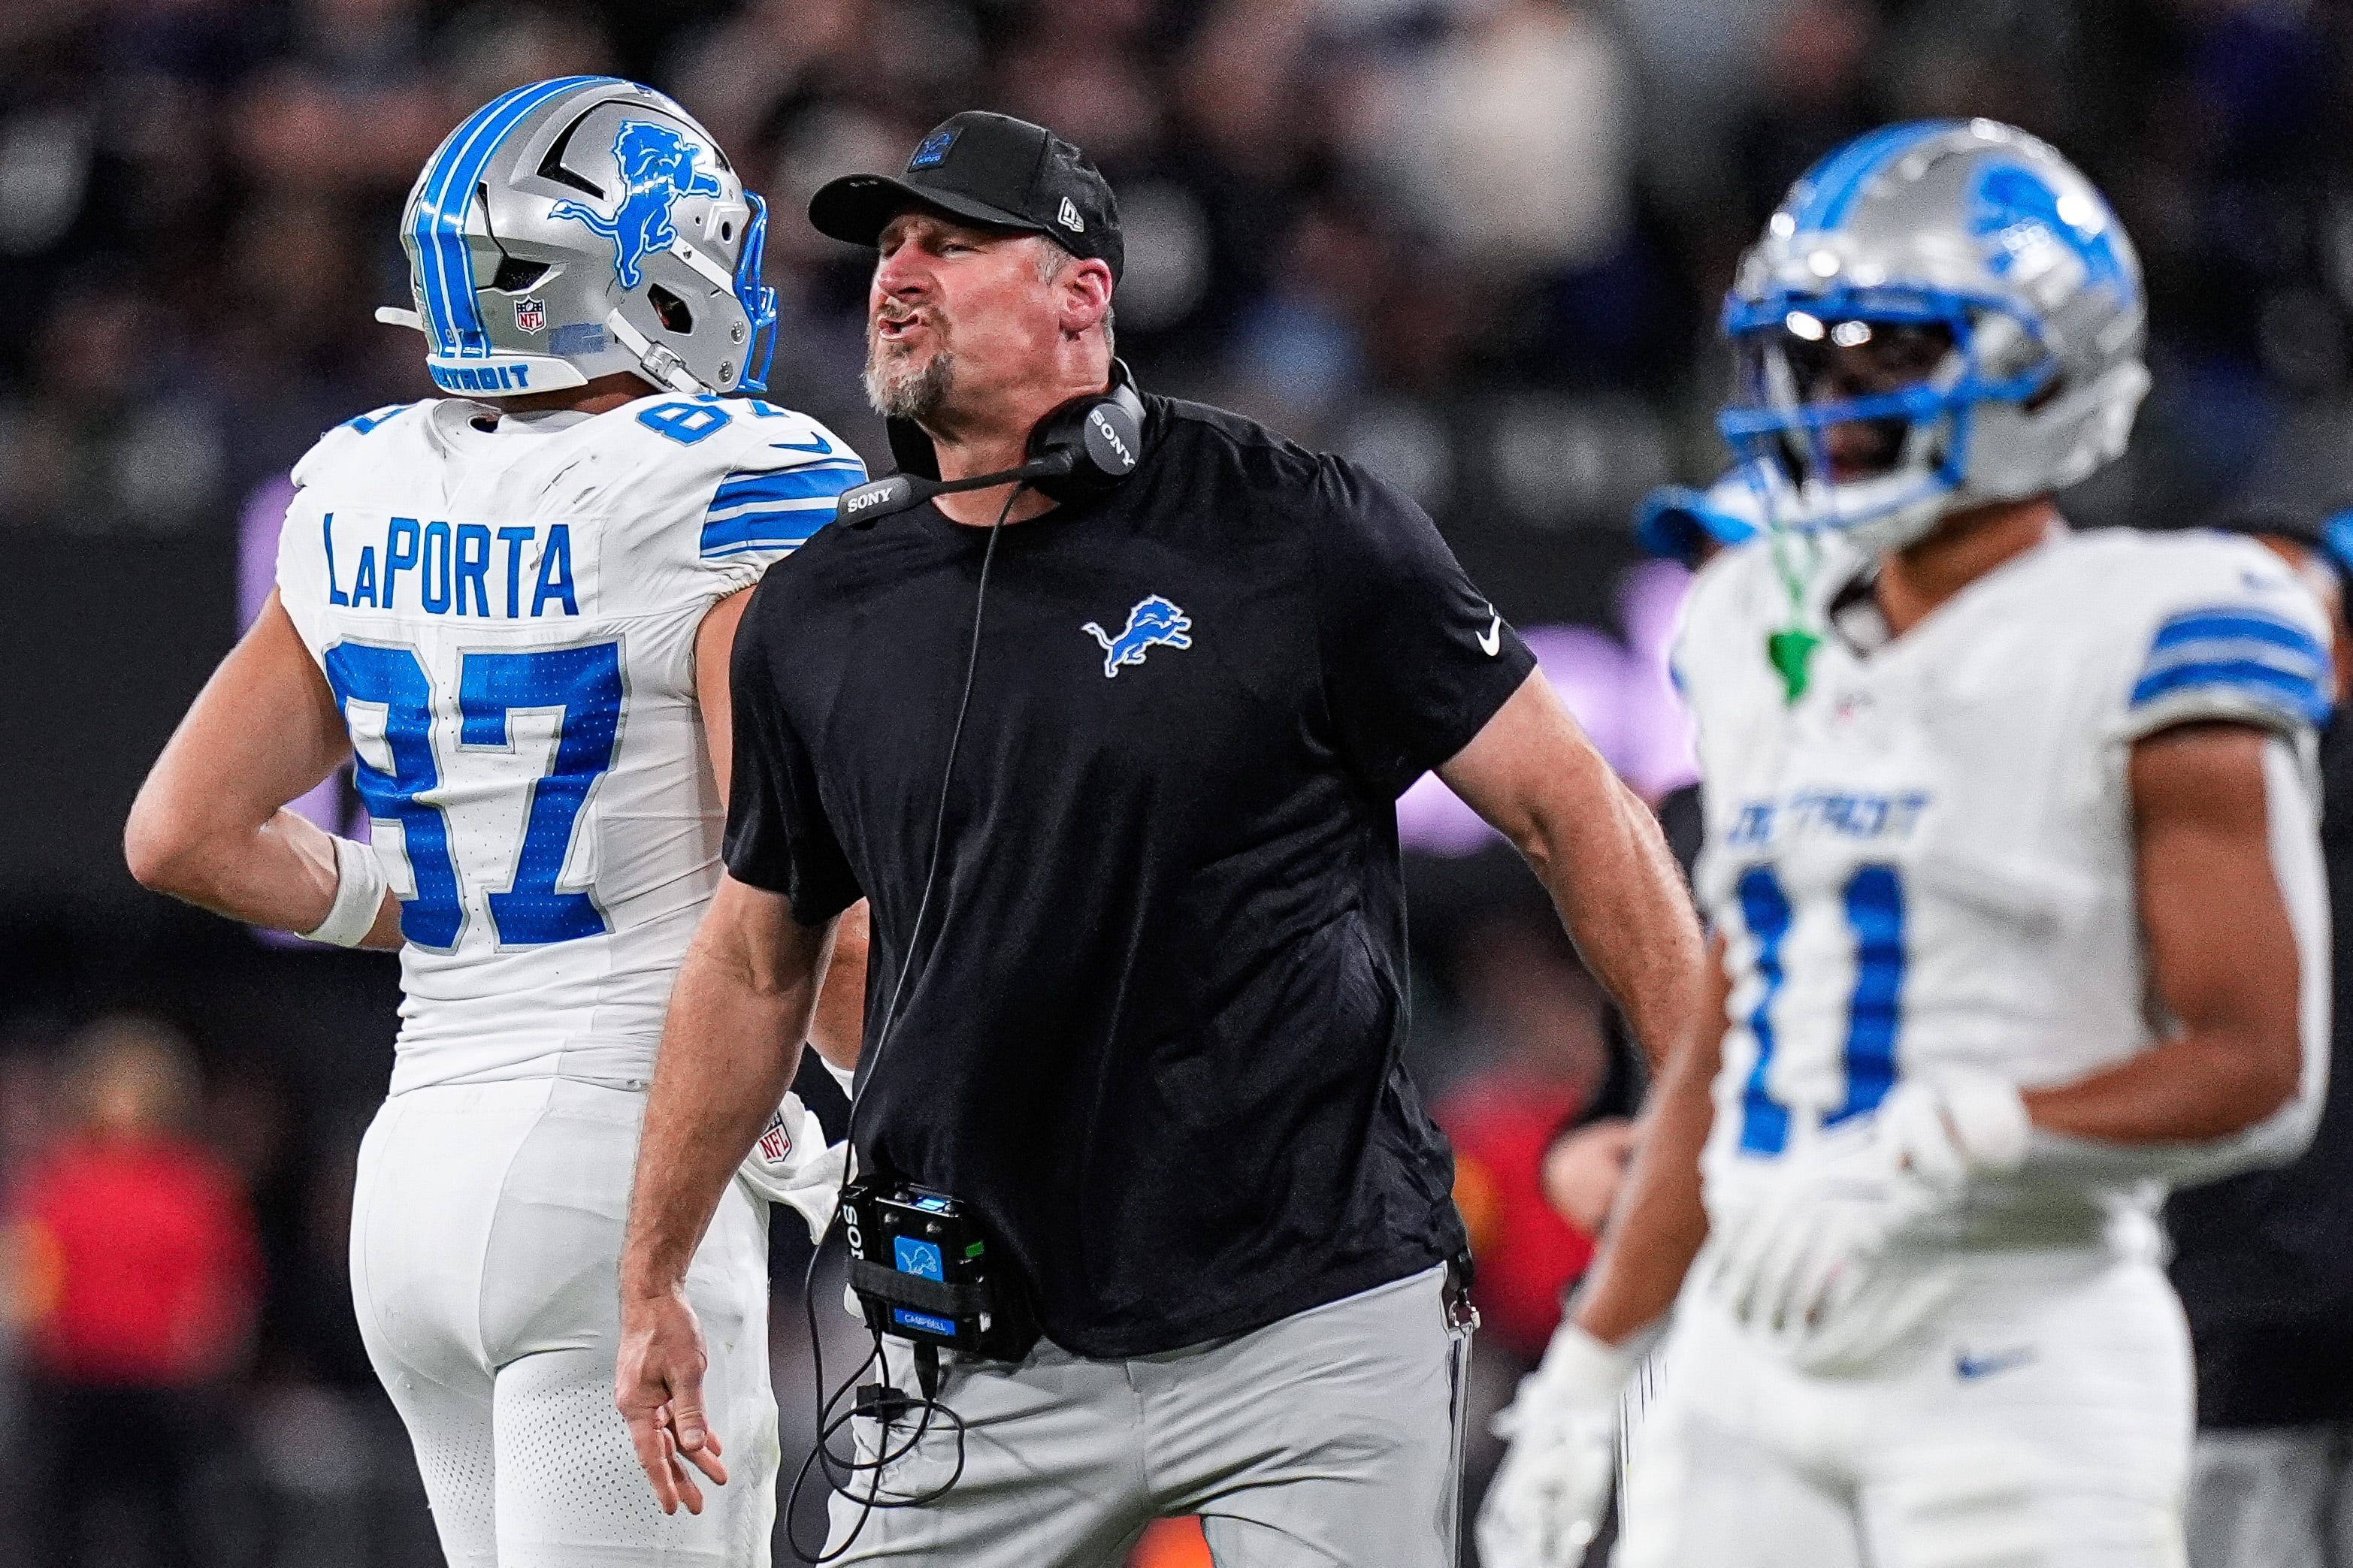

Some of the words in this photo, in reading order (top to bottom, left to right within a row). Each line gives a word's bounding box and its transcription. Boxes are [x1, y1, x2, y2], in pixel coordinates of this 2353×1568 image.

[520, 313, 542, 328] NFL
[445, 328, 464, 343] 87
[1090, 410, 1136, 467] SONY
[847, 487, 893, 512] SONY
[1738, 864, 1905, 1155] 11
[759, 1128, 789, 1159] NFL
